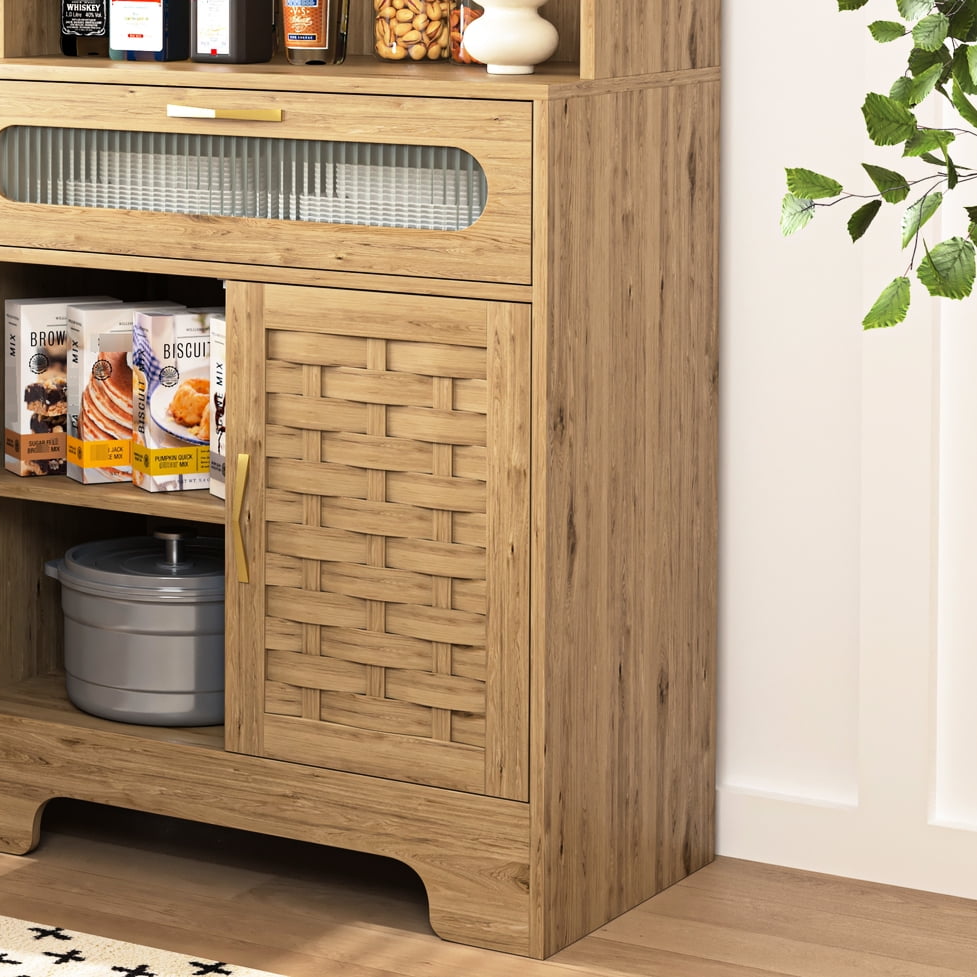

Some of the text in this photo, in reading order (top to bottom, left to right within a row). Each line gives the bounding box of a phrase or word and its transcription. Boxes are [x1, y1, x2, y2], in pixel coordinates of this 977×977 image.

[66, 4, 101, 12] WHISKEY
[30, 330, 66, 347] BROW
[216, 362, 224, 386] MIX
[138, 380, 146, 434] BISCUIT
